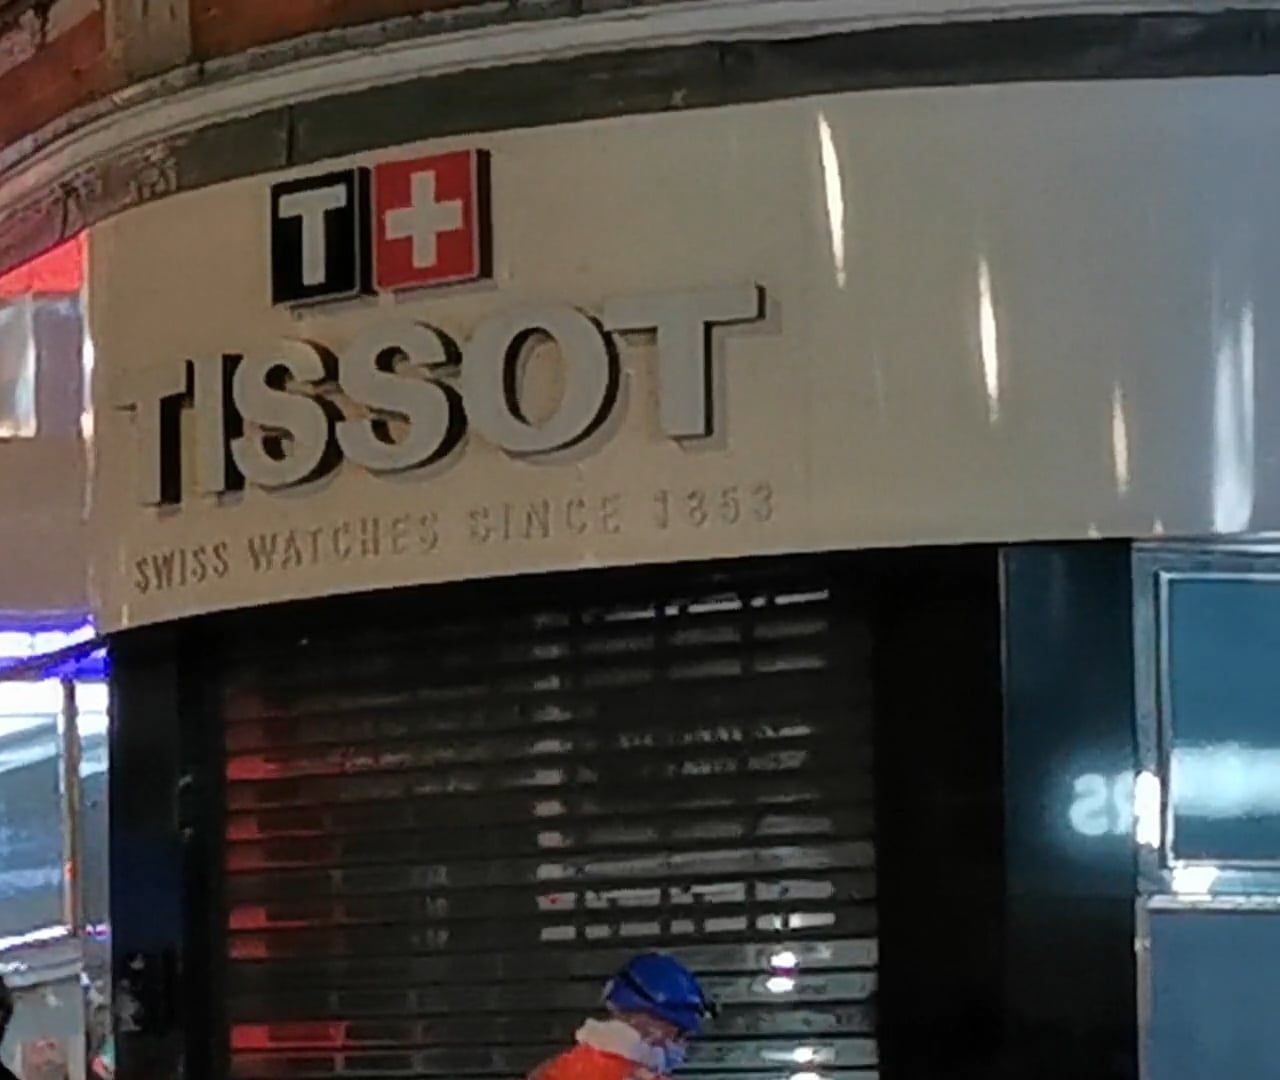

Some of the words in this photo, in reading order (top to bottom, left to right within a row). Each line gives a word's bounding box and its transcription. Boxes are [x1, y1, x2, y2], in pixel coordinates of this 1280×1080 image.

[278, 183, 348, 286] T
[112, 283, 768, 505] TISSOT
[133, 540, 230, 595] SWISS
[246, 511, 441, 574] WATCHES
[467, 491, 622, 543] SINCE
[651, 481, 776, 530] 1853
